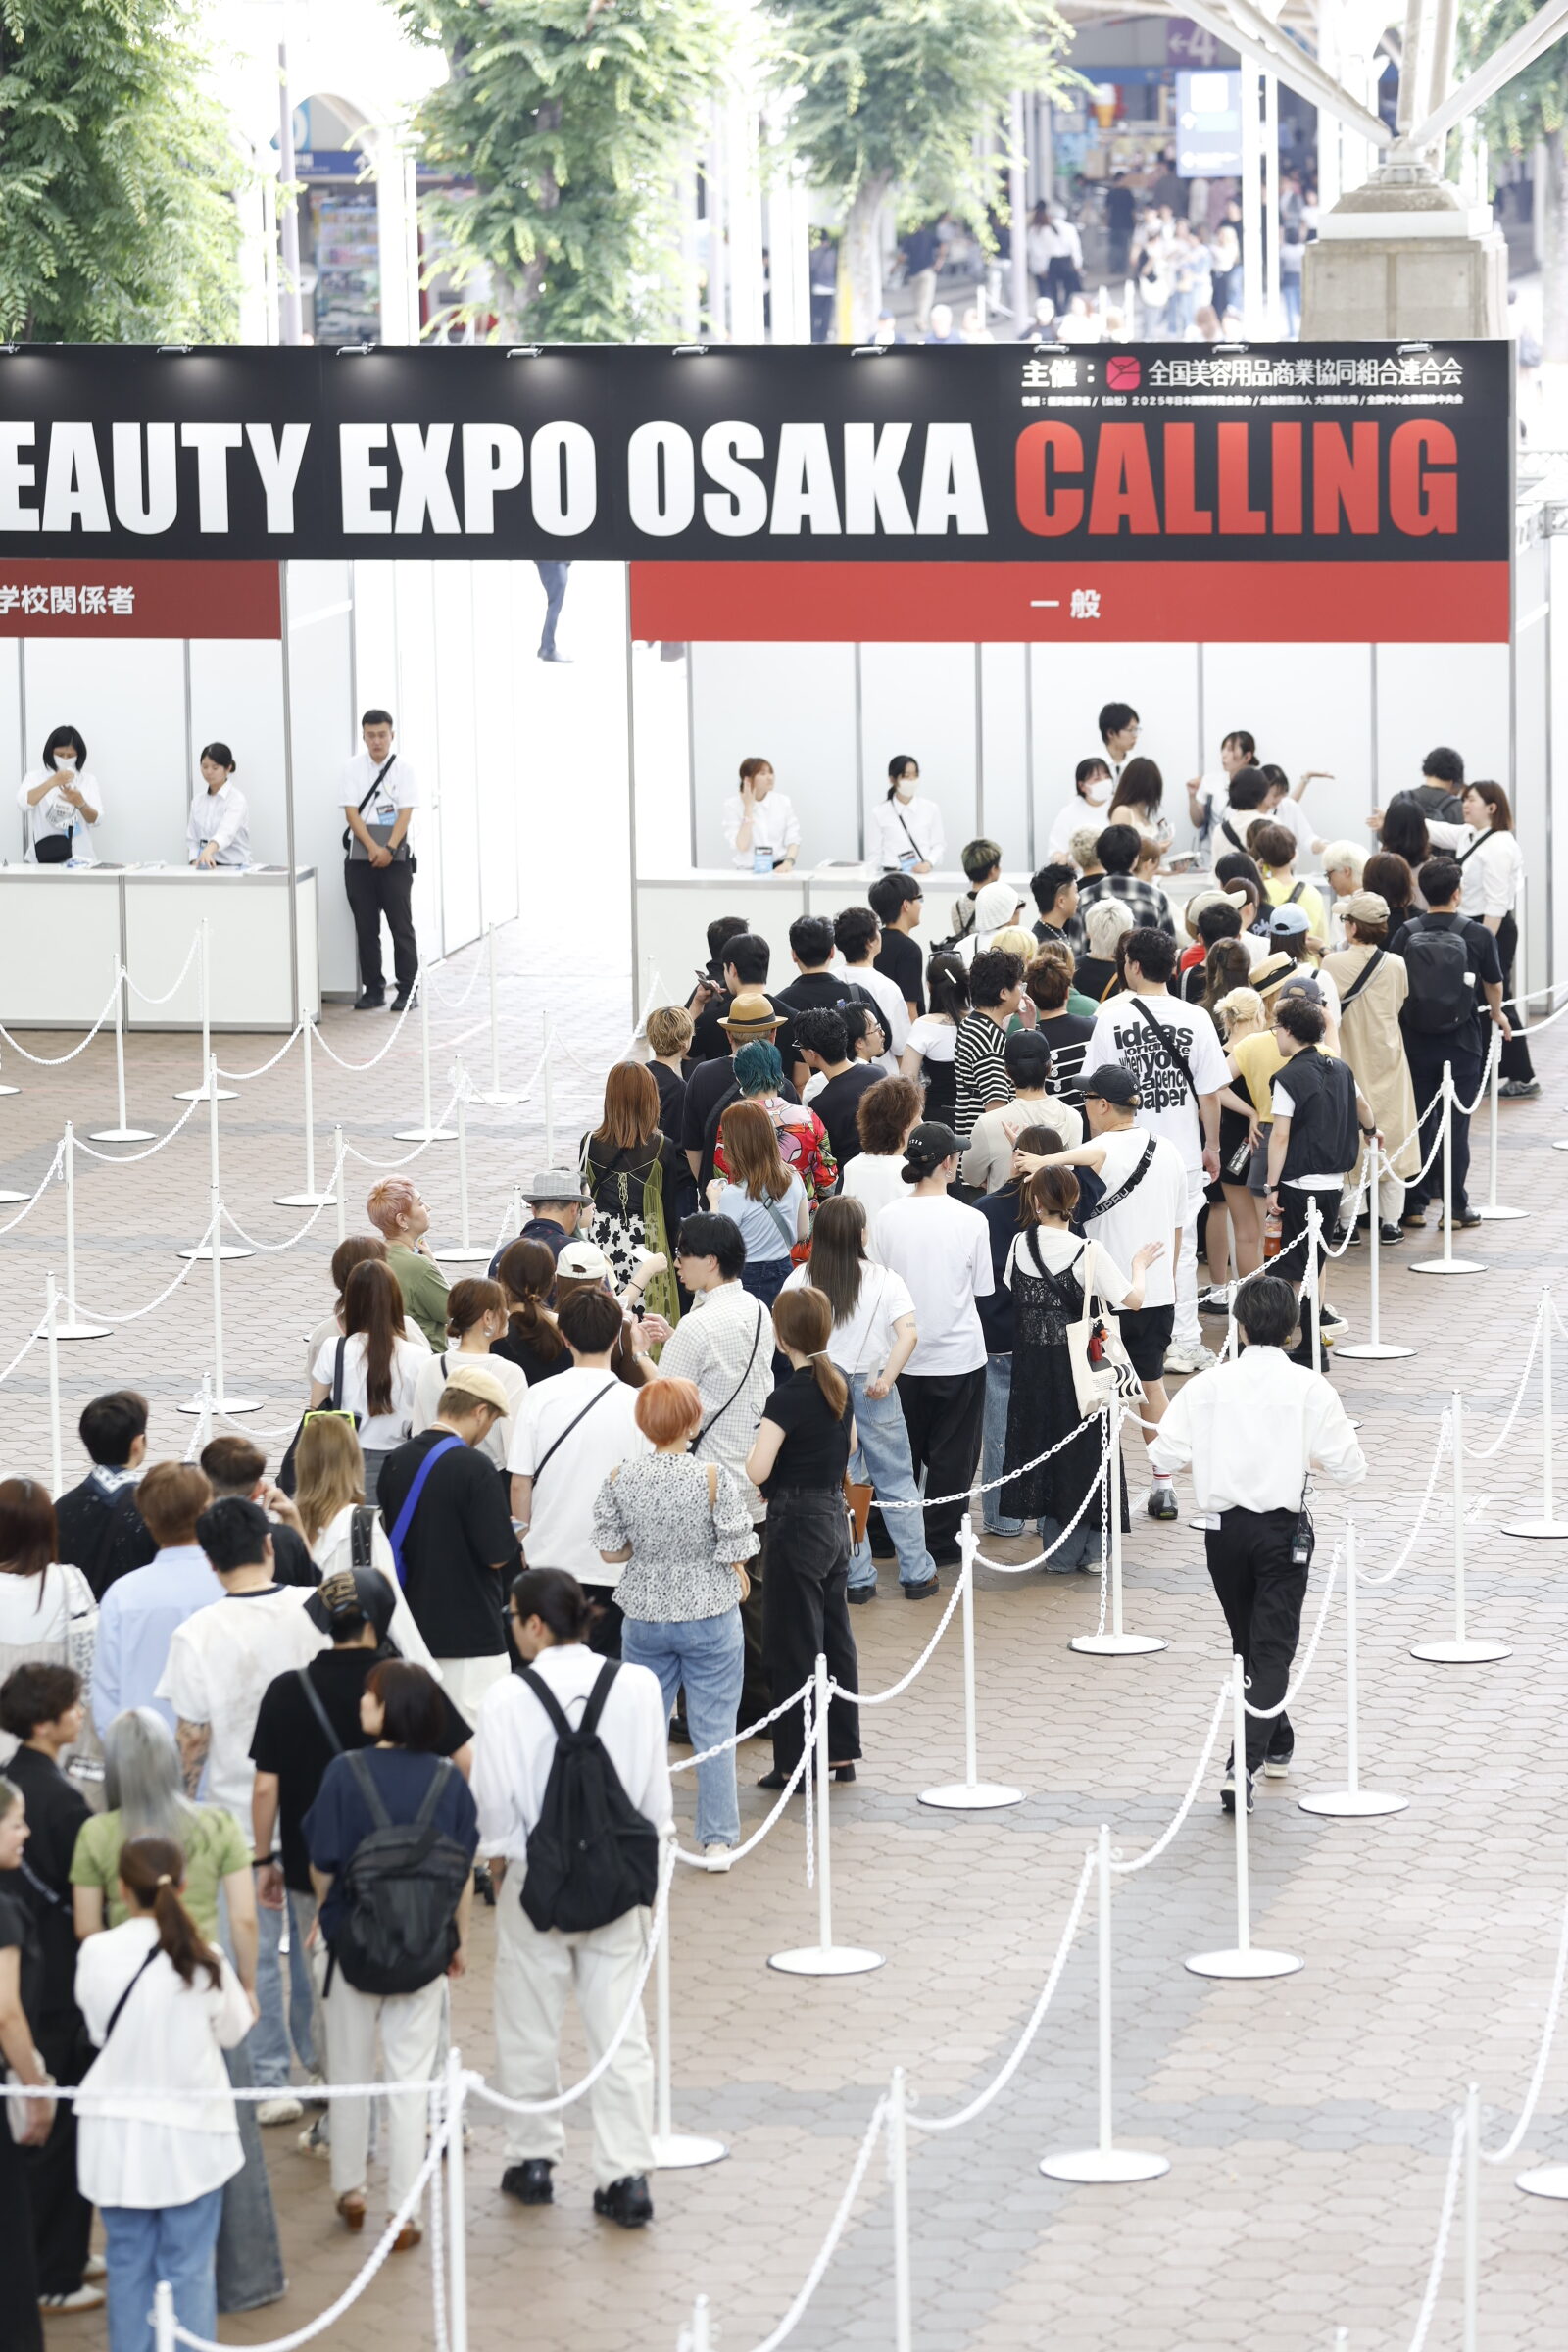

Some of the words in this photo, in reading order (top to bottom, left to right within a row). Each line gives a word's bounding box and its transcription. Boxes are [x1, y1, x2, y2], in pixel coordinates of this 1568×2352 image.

[1148, 359, 1463, 388] 全国美容用品商業協同組合連合会
[0, 421, 311, 535] EAUTY
[340, 421, 596, 536] EXPO
[628, 421, 988, 536] OSAKA
[1015, 419, 1458, 537] CALLING
[0, 585, 135, 614] 学校関係者
[1030, 589, 1101, 618] 一般
[1113, 1021, 1194, 1050] ideas
